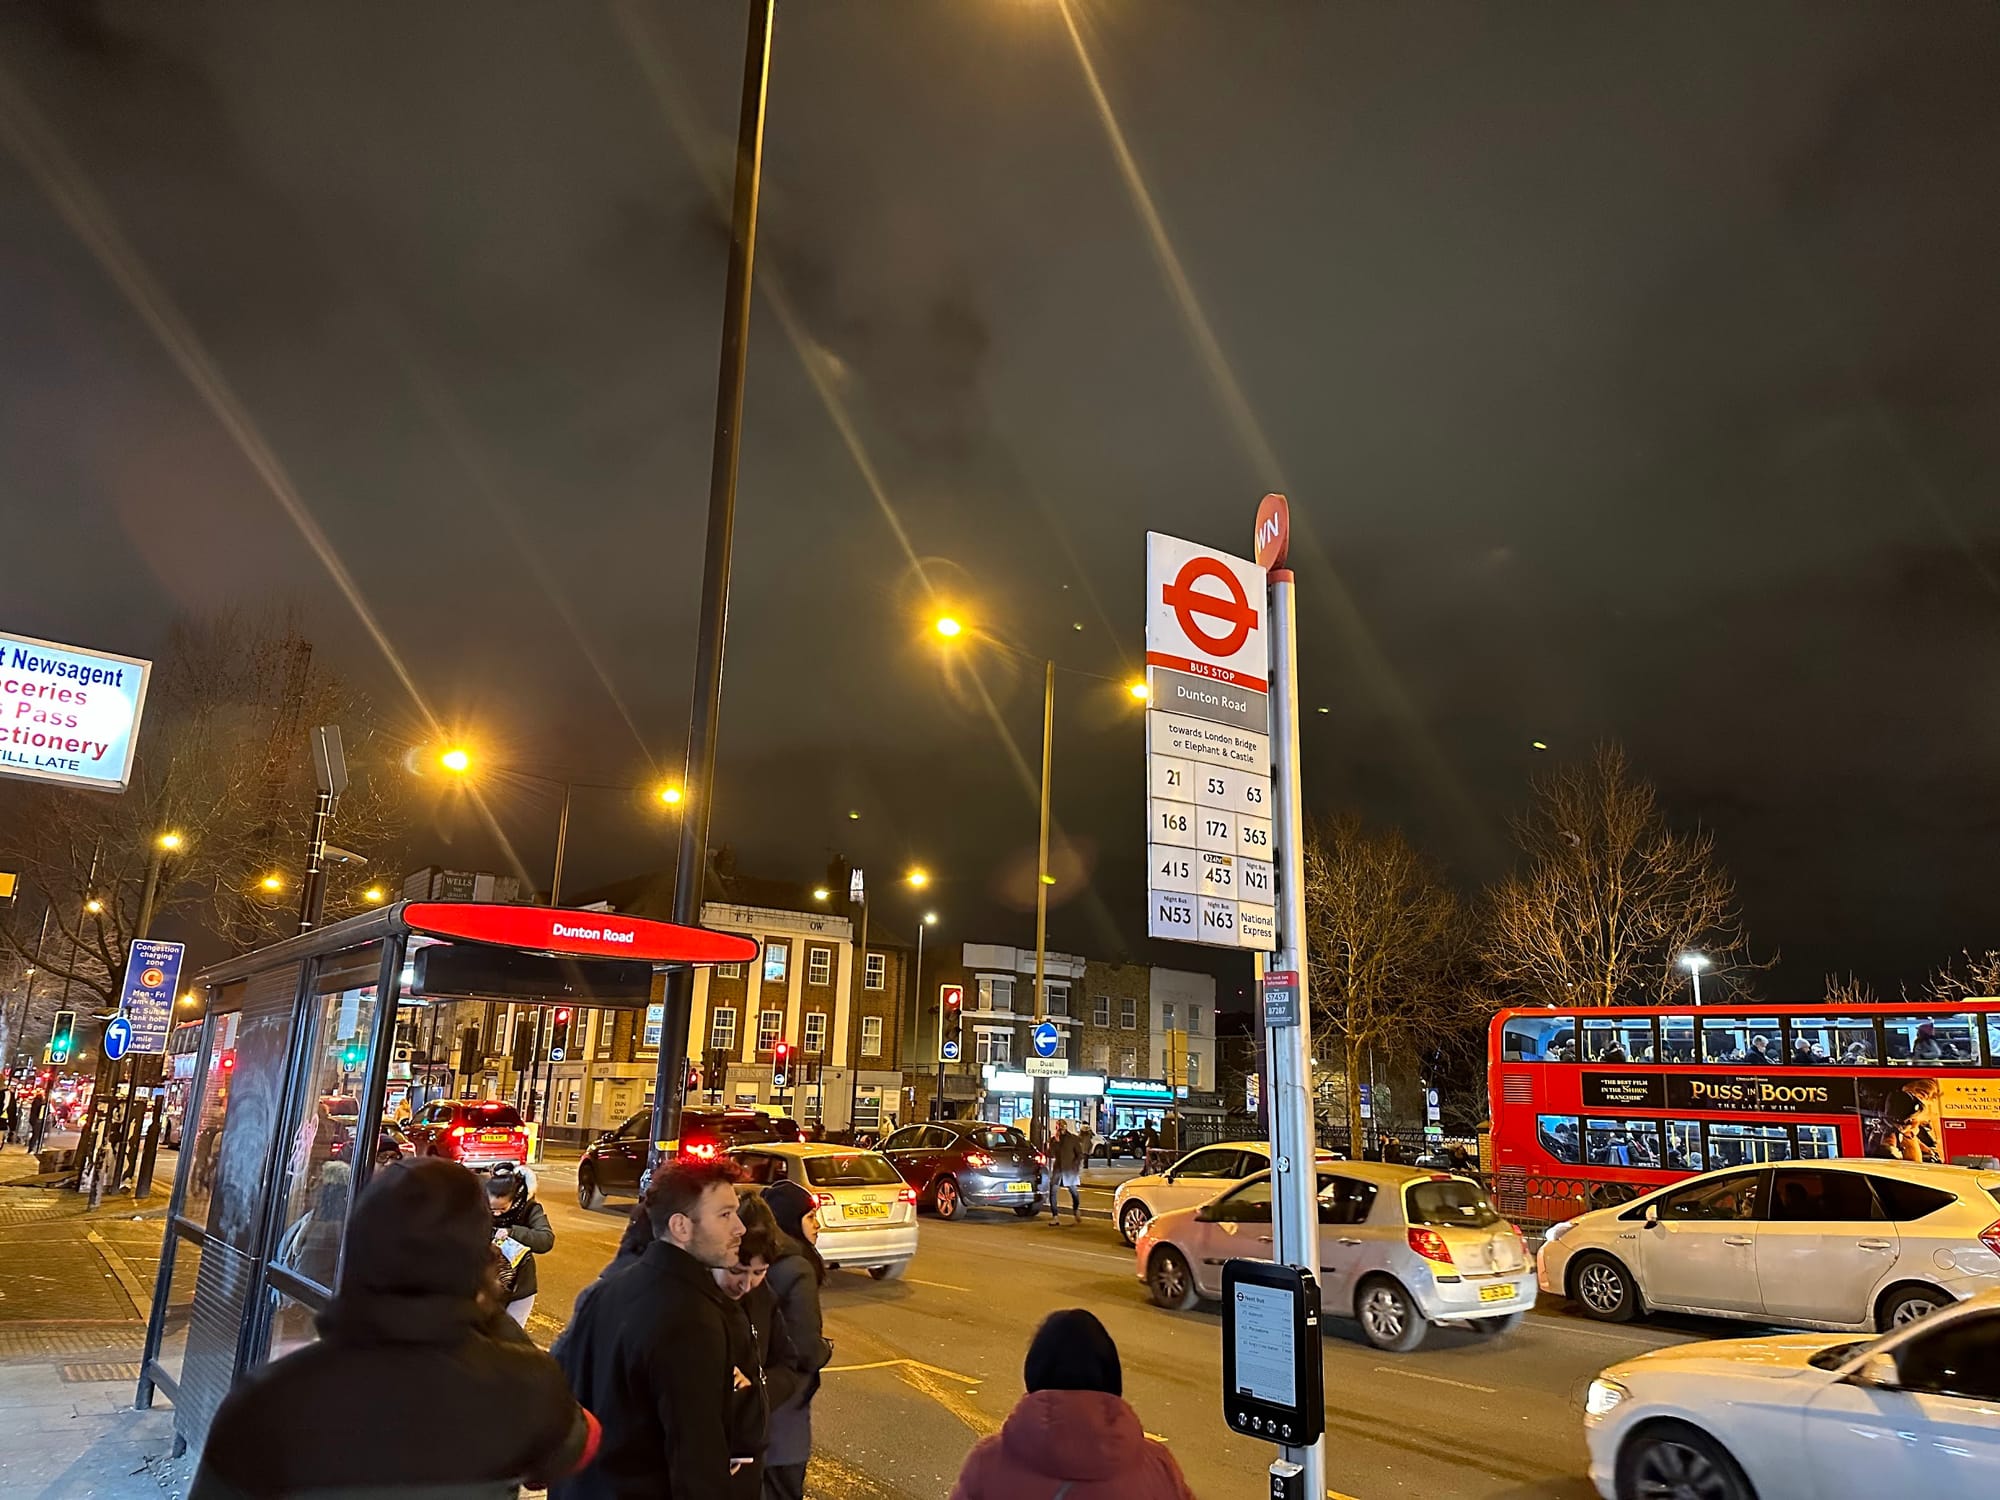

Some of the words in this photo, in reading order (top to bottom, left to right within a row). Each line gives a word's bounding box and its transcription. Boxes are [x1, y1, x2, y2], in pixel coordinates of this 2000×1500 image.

[1258, 512, 1279, 553] WN
[12, 648, 123, 687] Newsagent
[1190, 662, 1209, 675] BUS
[1211, 668, 1235, 681] STOP
[0, 679, 88, 706] ceries
[1177, 686, 1219, 706] Dunton
[1221, 695, 1247, 712] Road
[15, 701, 78, 728] Pass
[1169, 724, 1202, 738] towards
[1205, 731, 1232, 745] London
[1235, 738, 1257, 751] Bridge
[1185, 741, 1220, 755] Elephant
[1222, 748, 1228, 756] &
[1230, 750, 1254, 763] Castle
[35, 755, 80, 771] LATE
[1167, 769, 1180, 786] 21
[1208, 778, 1224, 795] 53
[1246, 786, 1262, 803] 63
[1162, 813, 1187, 831] 168
[1206, 820, 1227, 838] 172
[1243, 827, 1267, 845] 363
[1161, 861, 1189, 878] 415
[1205, 867, 1231, 885] 453
[446, 877, 472, 887] WELLS
[1245, 870, 1267, 889] N21
[1160, 905, 1191, 924] N53
[1203, 910, 1233, 929] N63
[1241, 912, 1273, 926] National
[552, 923, 601, 940] Dunton
[603, 928, 634, 943] Road
[1243, 925, 1272, 937] Express
[136, 943, 179, 953] Congestion
[139, 951, 172, 960] charging
[147, 1023, 165, 1031] 6pm
[1028, 1068, 1065, 1076] carriageway
[1689, 1080, 1743, 1099] PUSS
[1747, 1088, 1756, 1096] IN
[1760, 1083, 1828, 1102] BOOTS
